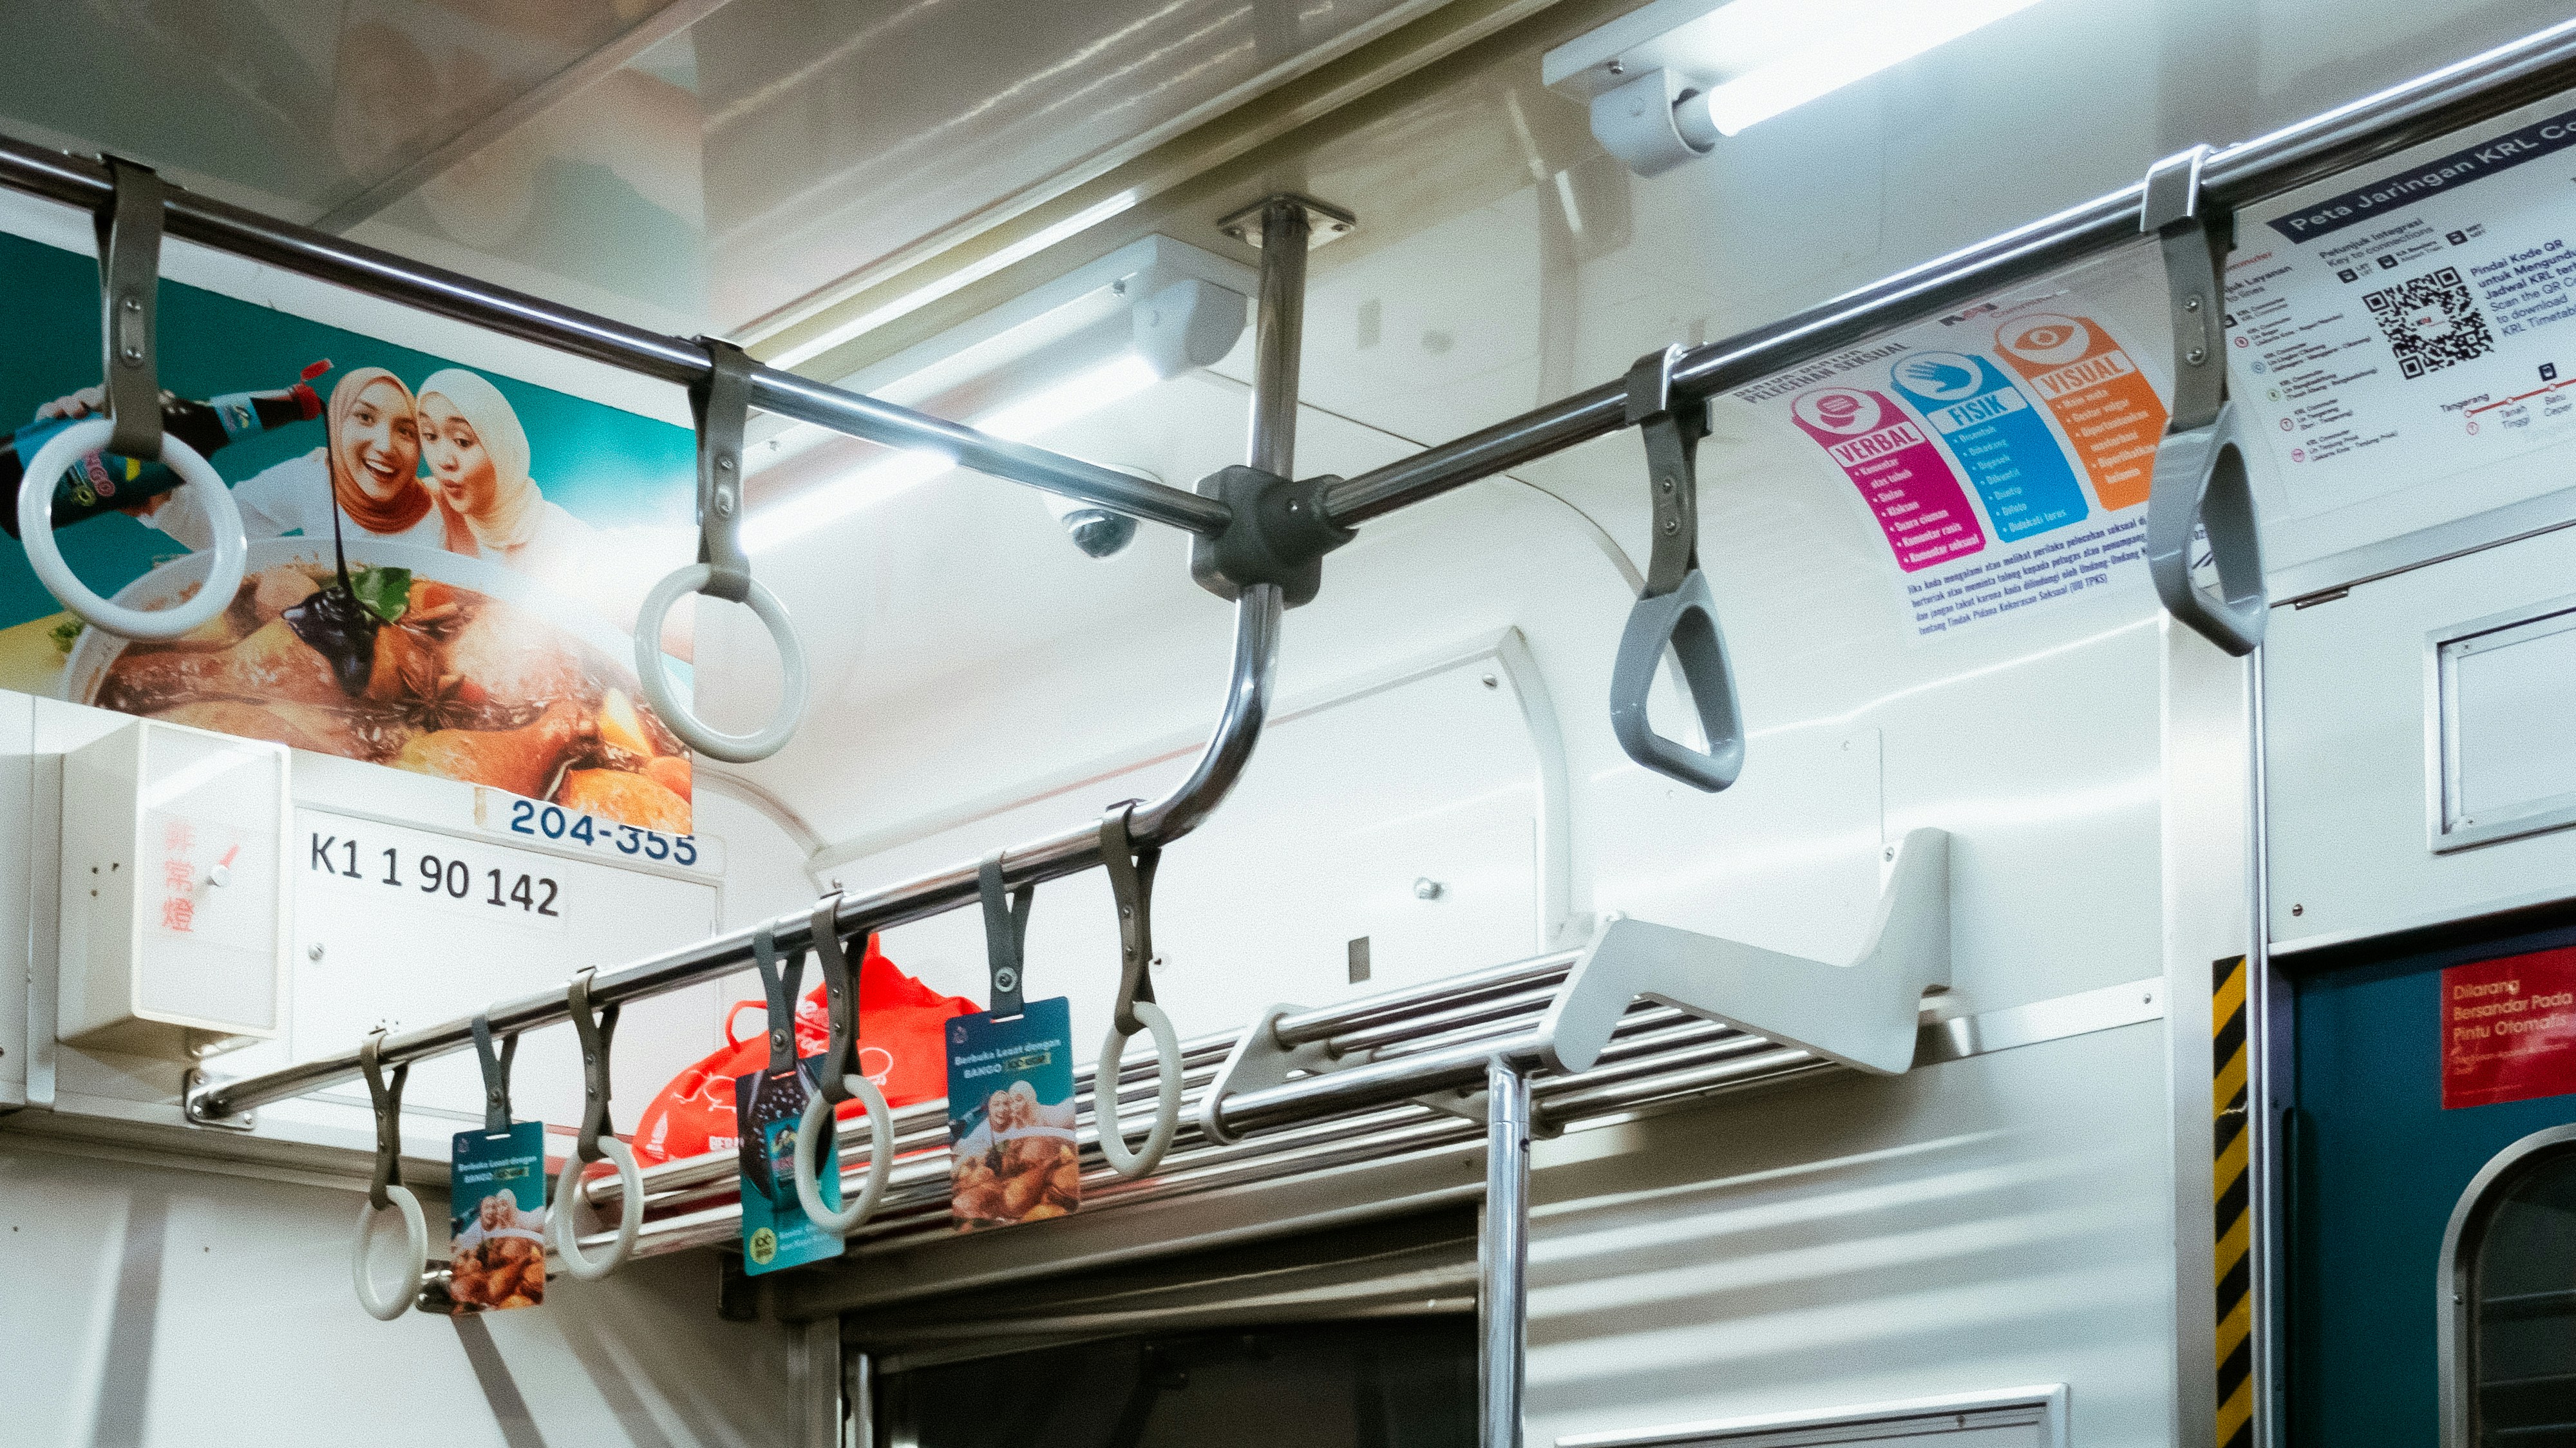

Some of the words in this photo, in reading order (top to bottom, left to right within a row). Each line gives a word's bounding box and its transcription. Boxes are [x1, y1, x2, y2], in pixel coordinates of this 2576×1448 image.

[2288, 202, 2352, 232] Peta
[2358, 159, 2474, 208] Jaringan
[2475, 133, 2539, 165] KRL
[2318, 236, 2371, 260] Petunjuk
[2371, 218, 2423, 241] Integrasi
[2326, 255, 2349, 268] Key
[2351, 250, 2364, 259] to
[2365, 227, 2434, 254] connections
[2470, 258, 2508, 277] Pindai
[2508, 246, 2542, 263] Kode
[2543, 238, 2563, 252] QR
[2244, 265, 2292, 285] Layanan
[2477, 270, 2512, 288] untuk
[2483, 278, 2528, 300] Jadwal
[2528, 269, 2554, 285] KRL
[2489, 294, 2519, 312] Scan
[2520, 288, 2540, 301] the
[2541, 280, 2561, 295] QR
[2496, 313, 2508, 324] to
[2509, 294, 2569, 319] download
[2501, 321, 2526, 336] KRL
[1743, 368, 1836, 405] PELECEHAN
[1833, 341, 1911, 372] SEKSUAL
[2040, 354, 2124, 393] VISUAL
[1947, 395, 2008, 425] FISIK
[2440, 394, 2489, 414] Tangerang
[1835, 424, 1918, 462] VERBAL
[1859, 458, 1899, 475] Komentar
[1870, 476, 1889, 488] atas
[1888, 469, 1913, 482] tubuh
[1894, 517, 1919, 531] Suara
[1918, 508, 1949, 523] ciuman
[2008, 514, 2044, 531] Didekati
[2044, 508, 2066, 520] terus
[1902, 528, 1941, 546] Komentar
[1943, 566, 1982, 584] mengalami
[1985, 560, 2001, 571] atau
[2002, 550, 2031, 566] melihat
[2033, 541, 2064, 557] perilaku
[2065, 529, 2105, 548] pelecehan
[2107, 519, 2137, 535] seksual
[1909, 544, 1948, 562] Komentar
[1911, 591, 1944, 607] berteriak
[1946, 587, 1962, 597] atau
[1964, 576, 1996, 592] meminta
[1996, 569, 2022, 584] tolong
[2022, 560, 2049, 575] kepada
[2051, 552, 2081, 568] petugas
[2083, 546, 2099, 557] atau
[1955, 598, 1975, 610] takut
[1975, 591, 2002, 604] karena
[1972, 605, 1997, 619] Pidana
[2038, 586, 2067, 601] Seksual
[511, 801, 697, 866] 204-355
[312, 833, 362, 879] K1
[382, 848, 402, 886] 1
[419, 855, 469, 899] 90
[486, 868, 559, 917] 142
[2454, 980, 2520, 1000] Dilarang
[2454, 1000, 2528, 1021] Bersandar
[2532, 993, 2573, 1009] Pada
[2454, 1026, 2490, 1042] Pintu
[2494, 1015, 2567, 1036] Otomatis
